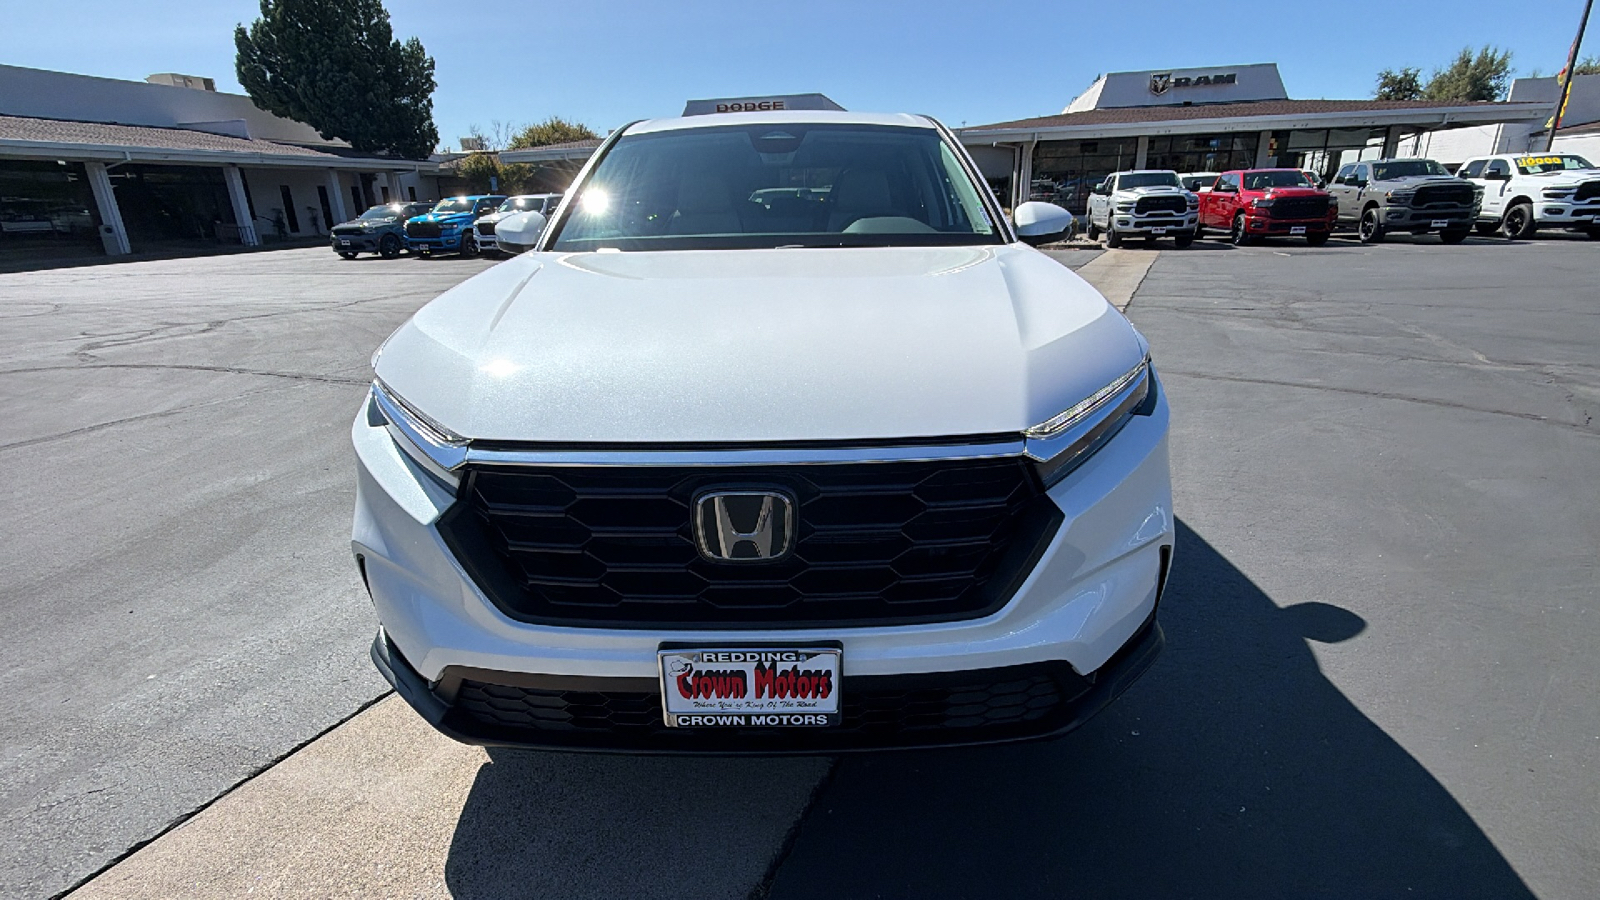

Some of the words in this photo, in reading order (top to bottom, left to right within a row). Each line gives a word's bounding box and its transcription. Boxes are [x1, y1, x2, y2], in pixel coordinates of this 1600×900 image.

[1174, 74, 1236, 87] RAM
[716, 102, 784, 113] DODGE
[703, 652, 797, 662] REDDING
[676, 662, 748, 700] Crown
[754, 660, 833, 700] Motors
[745, 701, 764, 710] King
[767, 701, 778, 710] Of
[677, 715, 746, 726] CROWN
[751, 714, 828, 726] MOTORS
